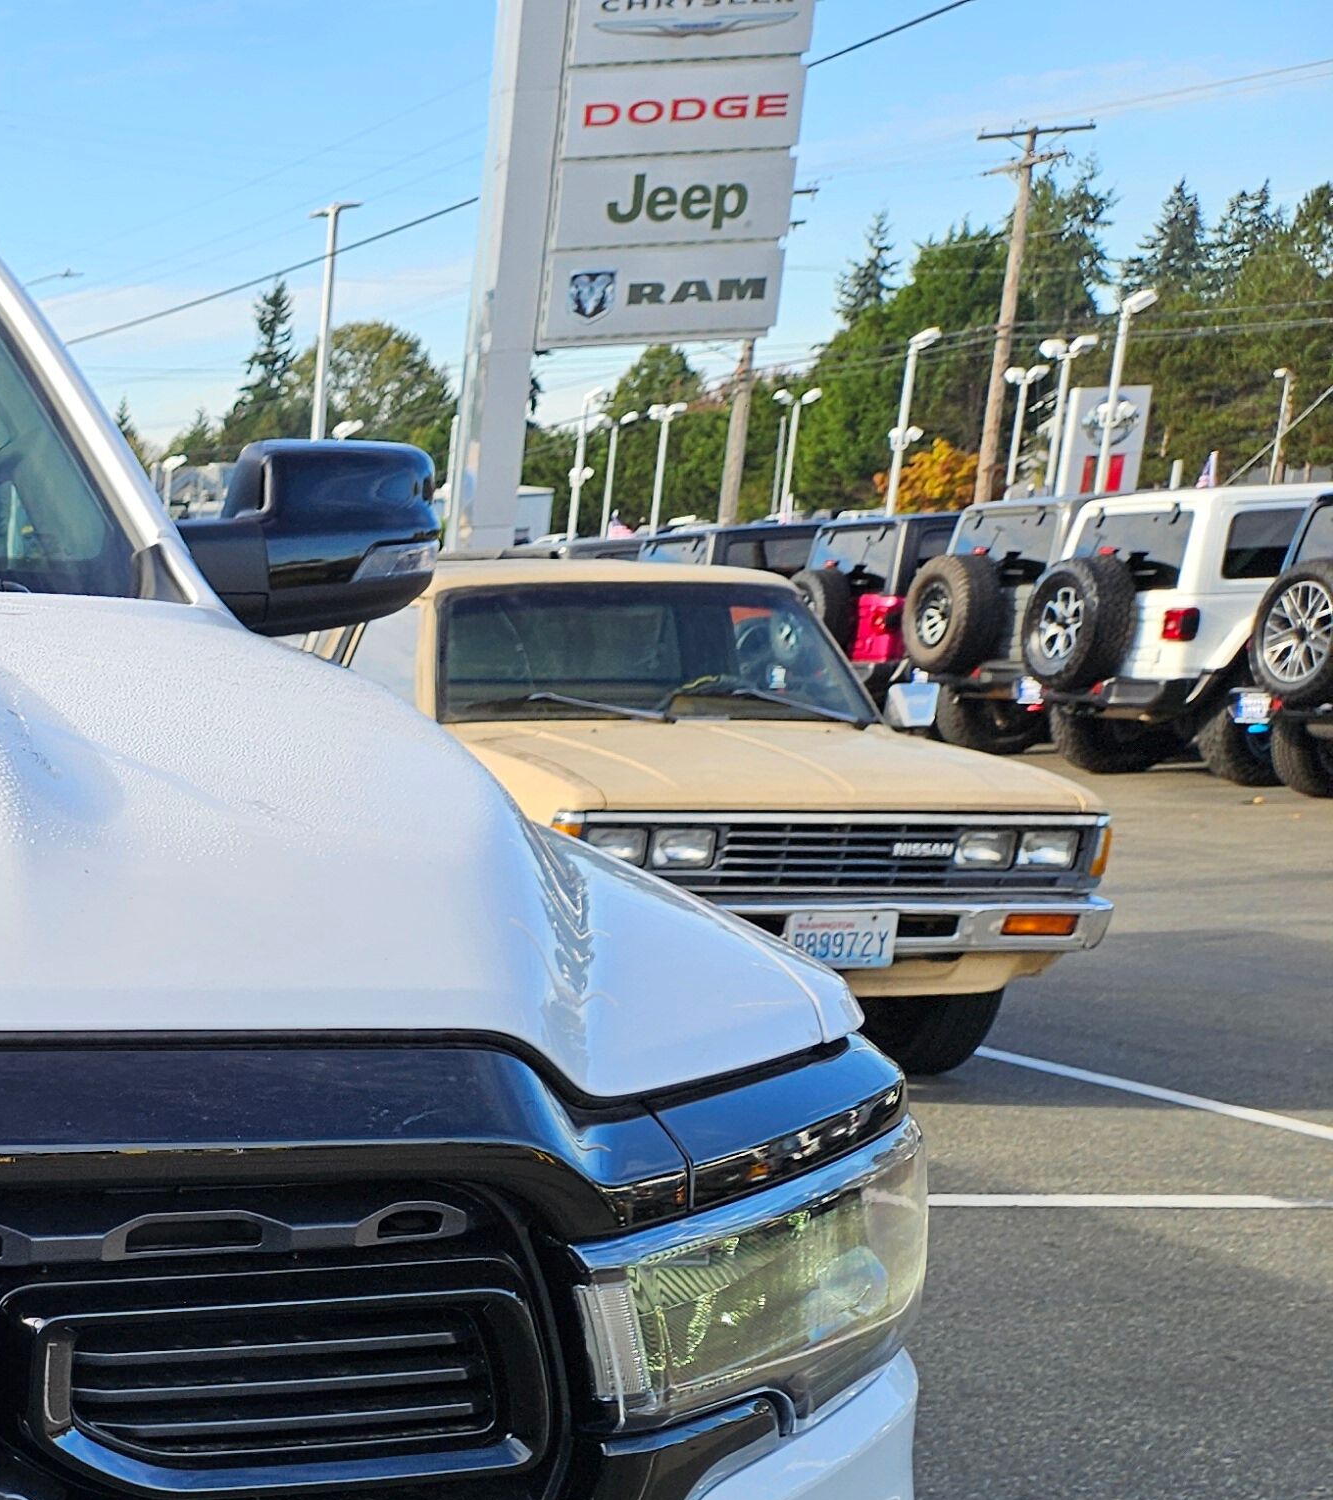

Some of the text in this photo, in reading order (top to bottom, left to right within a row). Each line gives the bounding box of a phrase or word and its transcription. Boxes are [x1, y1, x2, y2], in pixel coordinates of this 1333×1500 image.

[583, 93, 790, 128] DODGE
[607, 173, 749, 230] Jeep
[626, 277, 768, 306] RAM
[892, 842, 955, 857] NISSAN
